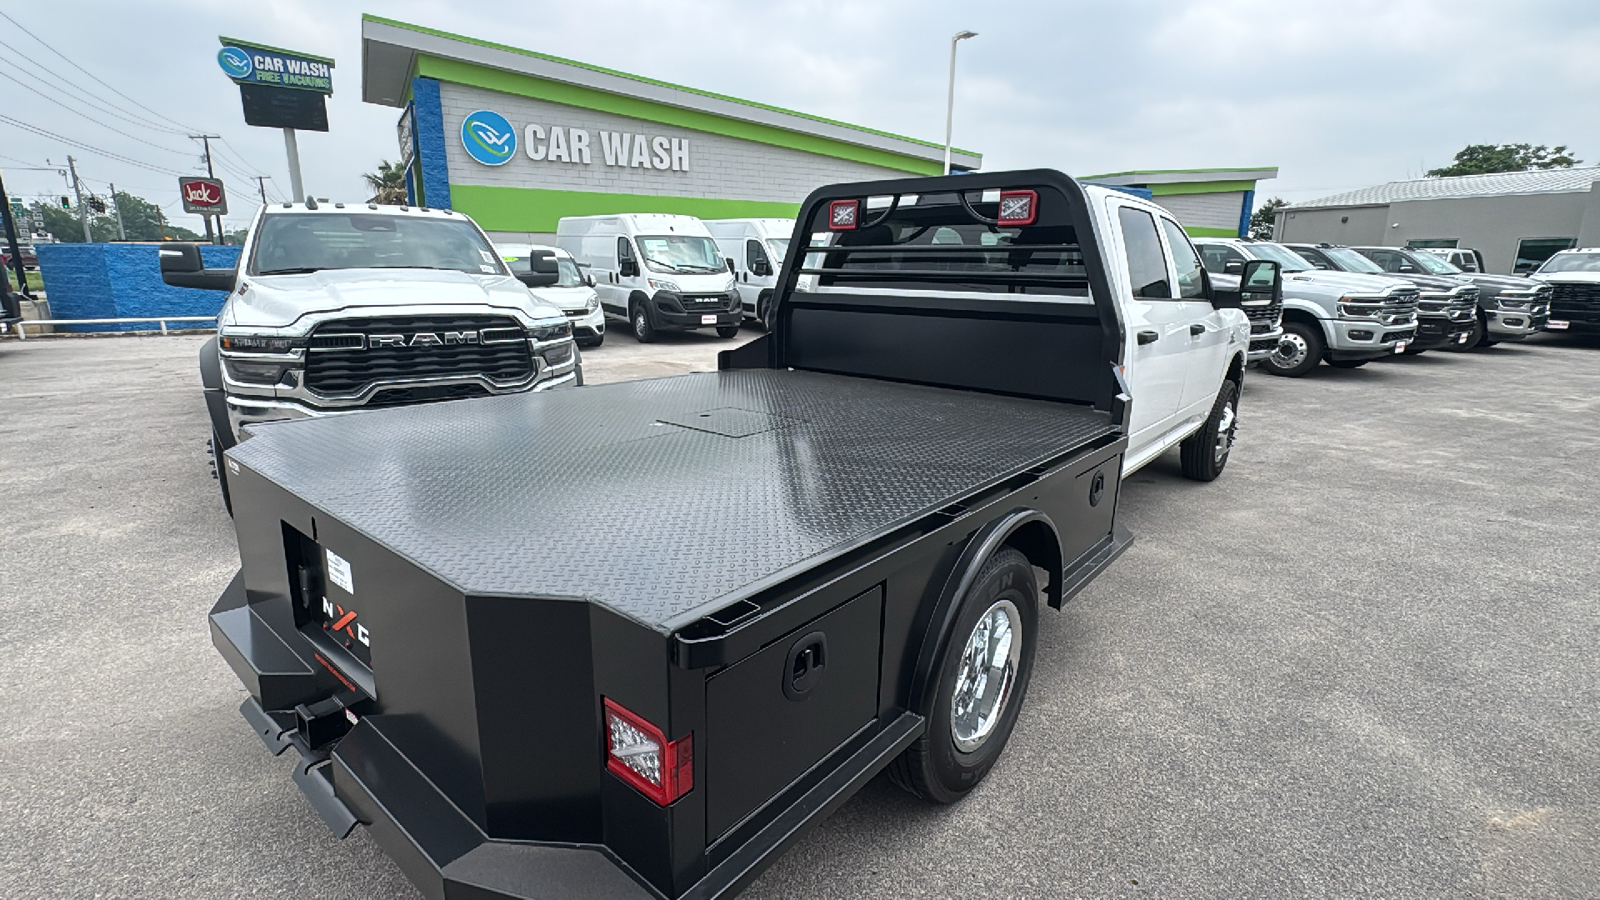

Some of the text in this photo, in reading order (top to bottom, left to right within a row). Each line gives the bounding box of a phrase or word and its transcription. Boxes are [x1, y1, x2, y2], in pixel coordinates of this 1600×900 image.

[254, 55, 329, 77] CAR WASH
[255, 69, 330, 88] FREE VACUUMS
[524, 123, 690, 171] CAR WASH
[186, 183, 220, 203] Jack
[368, 330, 479, 349] RAM
